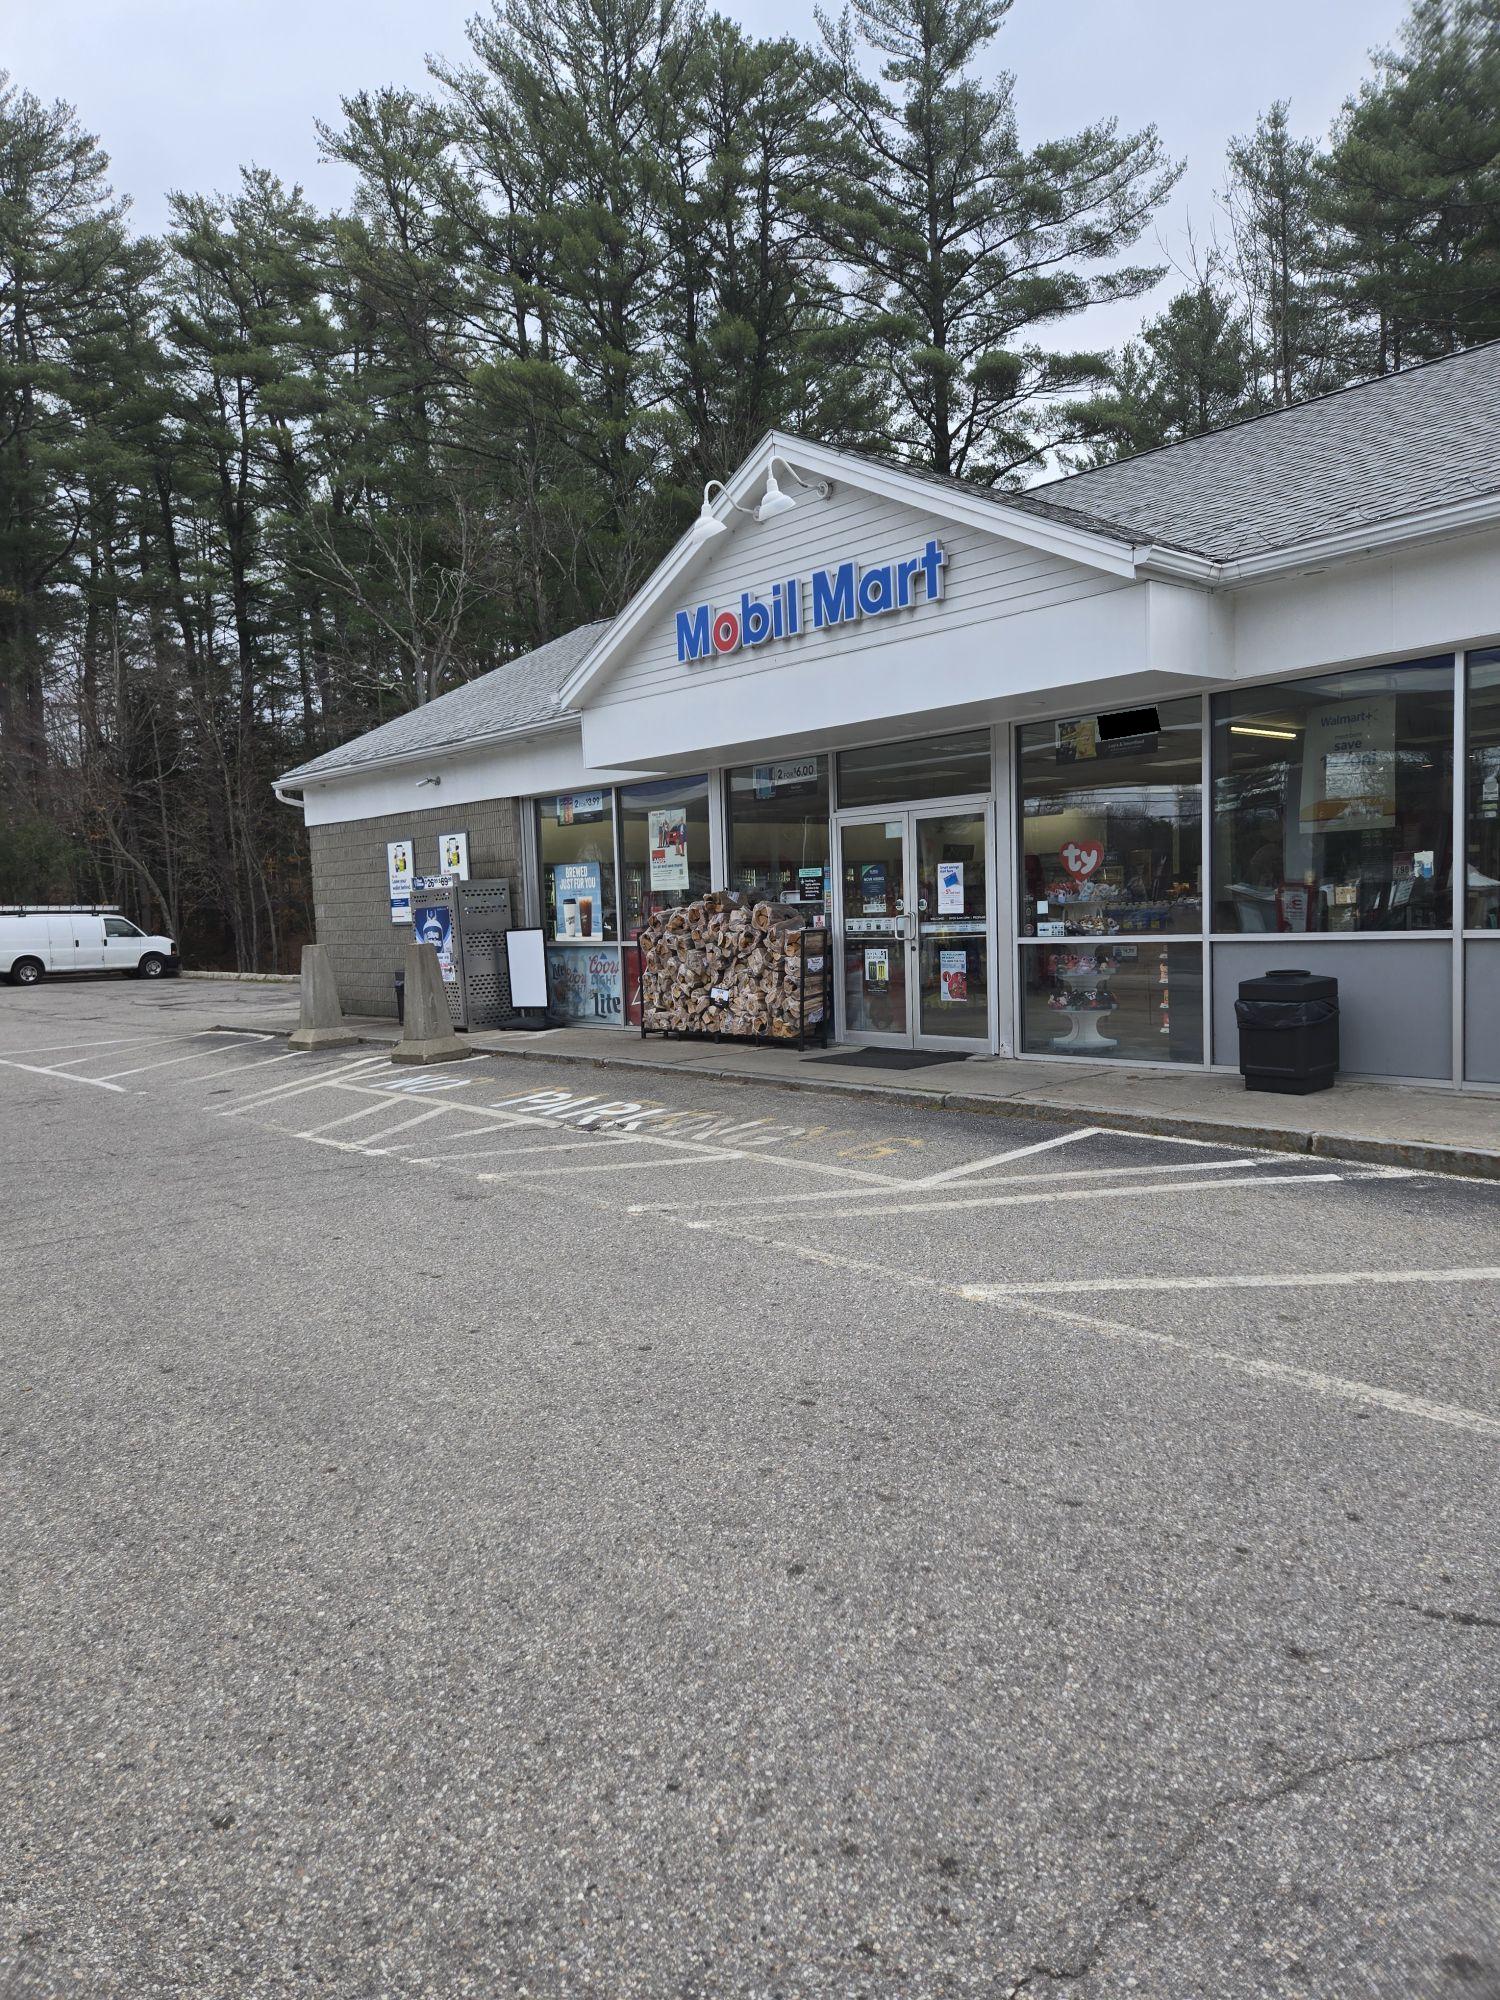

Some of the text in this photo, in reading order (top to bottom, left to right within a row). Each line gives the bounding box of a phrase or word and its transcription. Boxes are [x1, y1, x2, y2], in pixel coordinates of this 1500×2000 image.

[675, 539, 949, 663] Mobil Mart
[1320, 709, 1374, 728] Walmart+
[1334, 739, 1362, 752] save
[777, 769, 783, 779] 2
[793, 765, 814, 777] $6.00
[574, 799, 579, 808] 2
[1062, 843, 1098, 875] ty
[565, 866, 588, 878] BREWED
[560, 876, 596, 890] JUST FOR YOU
[588, 954, 620, 974] Coors
[590, 992, 621, 1019] Lite
[368, 1074, 471, 1094] NO
